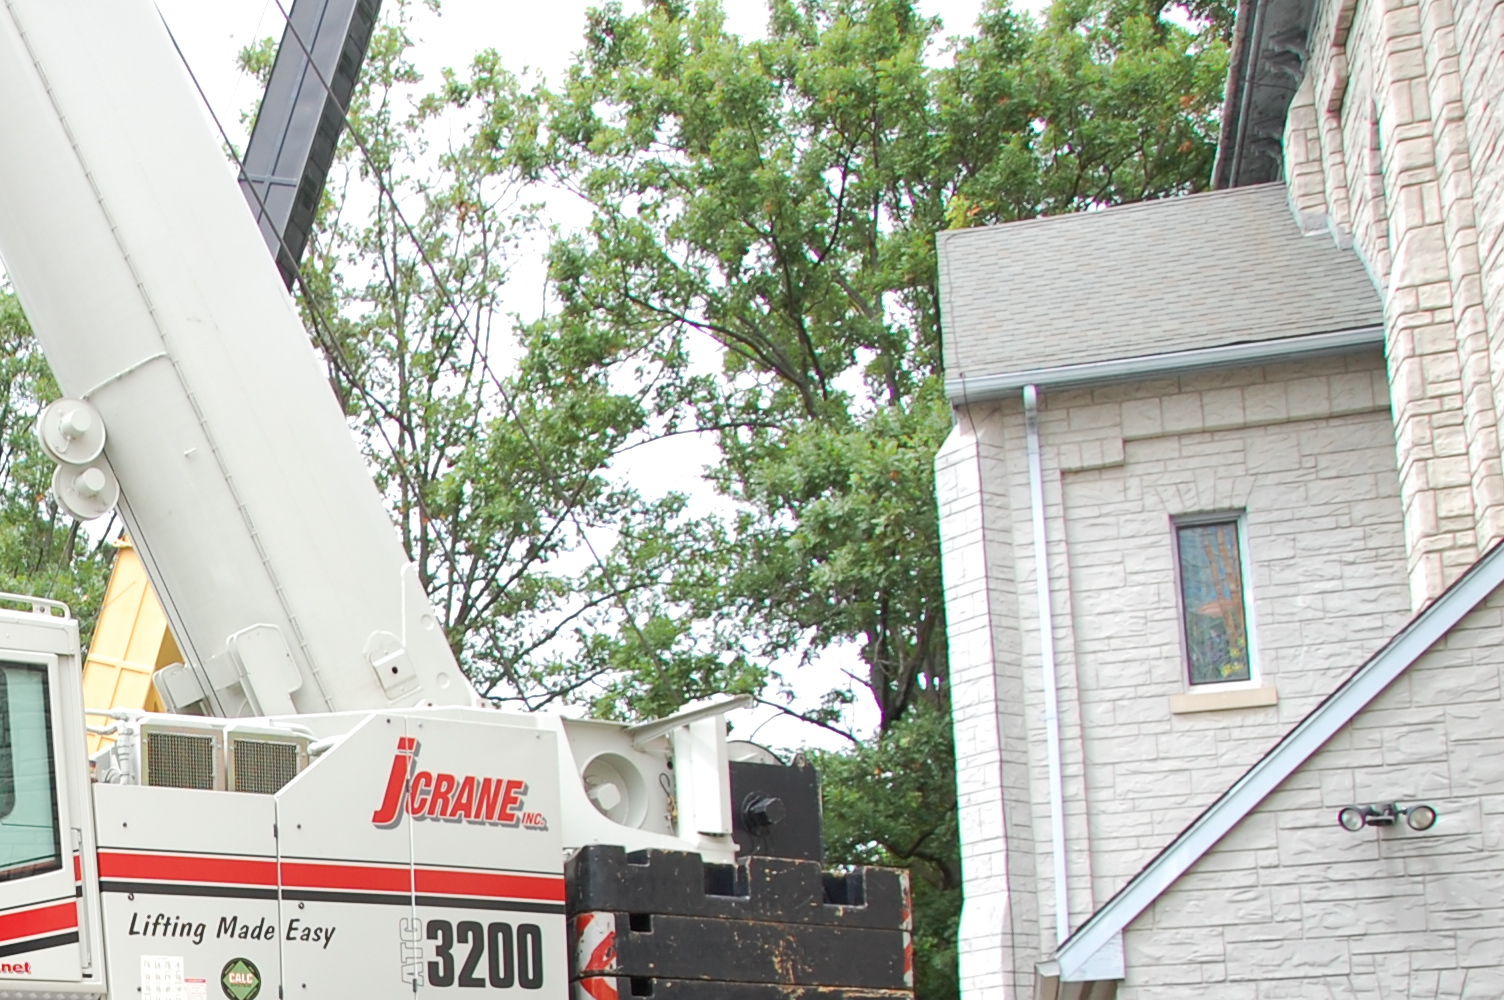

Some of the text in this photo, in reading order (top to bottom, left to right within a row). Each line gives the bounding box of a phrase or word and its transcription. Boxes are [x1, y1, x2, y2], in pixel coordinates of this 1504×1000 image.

[128, 912, 336, 949] Lifting Made Easy
[426, 919, 543, 990] 3200
[228, 972, 254, 984] CALC
